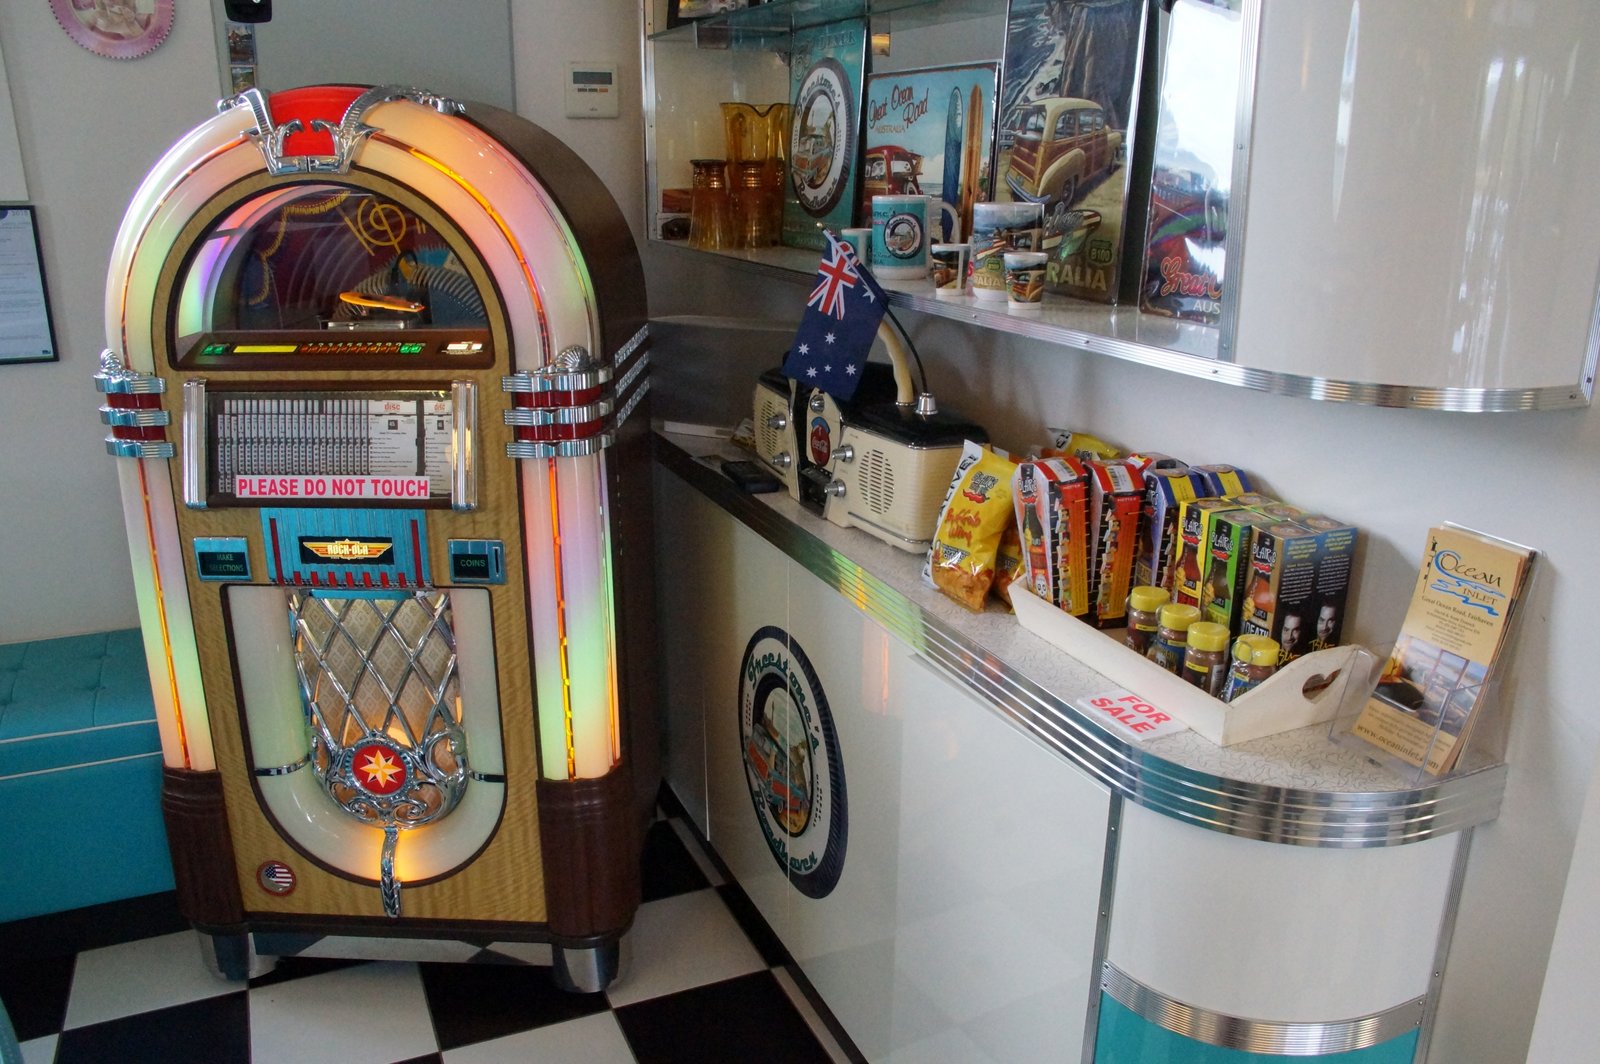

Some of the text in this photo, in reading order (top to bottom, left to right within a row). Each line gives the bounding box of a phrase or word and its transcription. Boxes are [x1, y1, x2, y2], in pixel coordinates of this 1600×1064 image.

[869, 84, 914, 129] Great Ocean
[903, 88, 929, 128] Road
[1160, 257, 1210, 297] Great
[238, 479, 428, 497] PLEASE DO NOT TOUCH
[216, 553, 234, 561] MAKE
[327, 545, 368, 555] ROCK-OLA
[460, 559, 486, 568] COINS
[1440, 553, 1502, 588] Ocean
[1463, 588, 1497, 605] INLET
[1090, 697, 1156, 733] SALE
[1118, 695, 1171, 724] FOR
[1357, 724, 1439, 770] www.oceaninlet.cm
